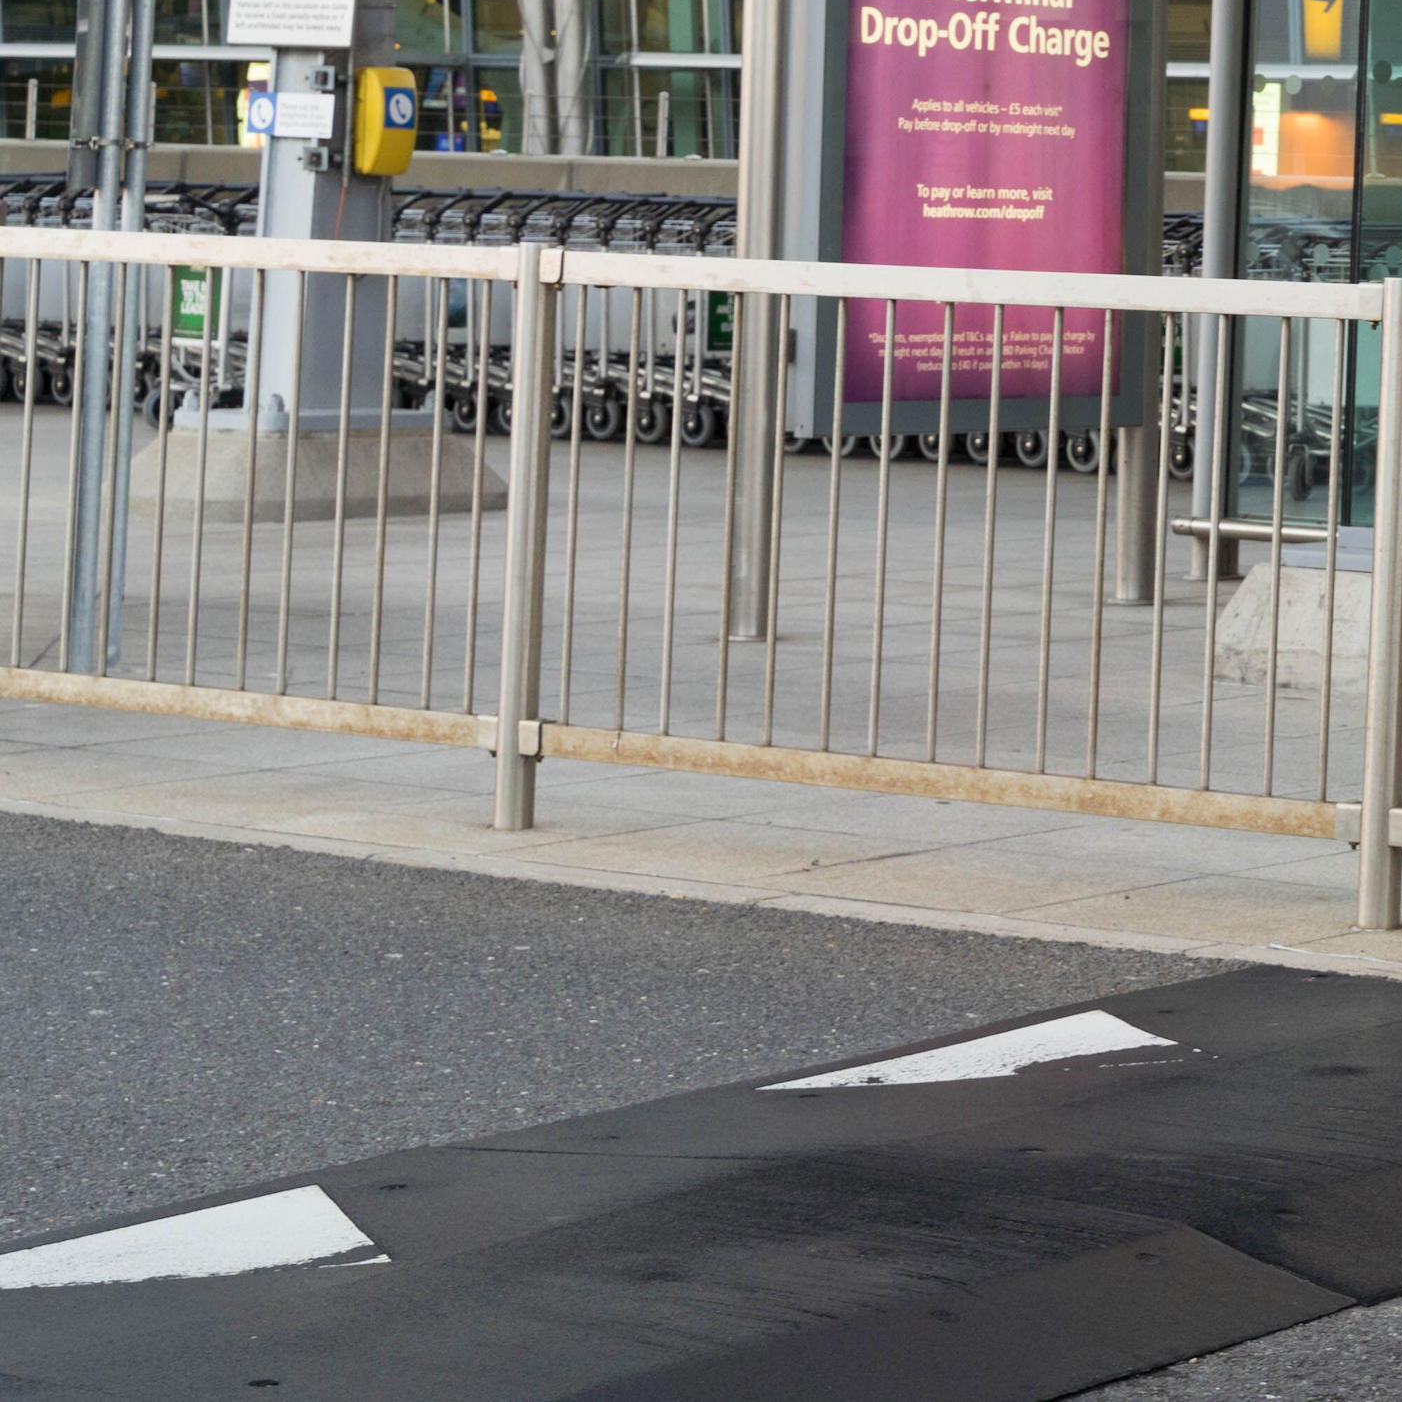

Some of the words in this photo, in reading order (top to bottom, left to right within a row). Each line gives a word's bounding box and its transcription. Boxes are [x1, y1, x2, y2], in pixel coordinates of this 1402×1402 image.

[861, 6, 1000, 57] Drop-Off
[1008, 15, 1111, 67] Charge
[912, 99, 942, 114] Applies
[943, 101, 952, 112] to
[953, 100, 964, 112] all
[965, 101, 1000, 115] vehicles
[1008, 102, 1022, 115] £5
[1022, 104, 1043, 117] each
[898, 117, 913, 133] Pay
[914, 118, 941, 131] before
[978, 123, 988, 133] or
[989, 121, 1002, 136] by
[1002, 121, 1043, 138] midnight
[1043, 124, 1060, 136] next
[1061, 124, 1076, 139] day
[916, 184, 930, 198] To
[931, 186, 950, 202] pay
[952, 187, 965, 199] or
[966, 185, 995, 199] learn
[998, 189, 1030, 202] more,
[1032, 186, 1054, 201] visit
[923, 203, 1045, 222] heathrow.com/dropoff
